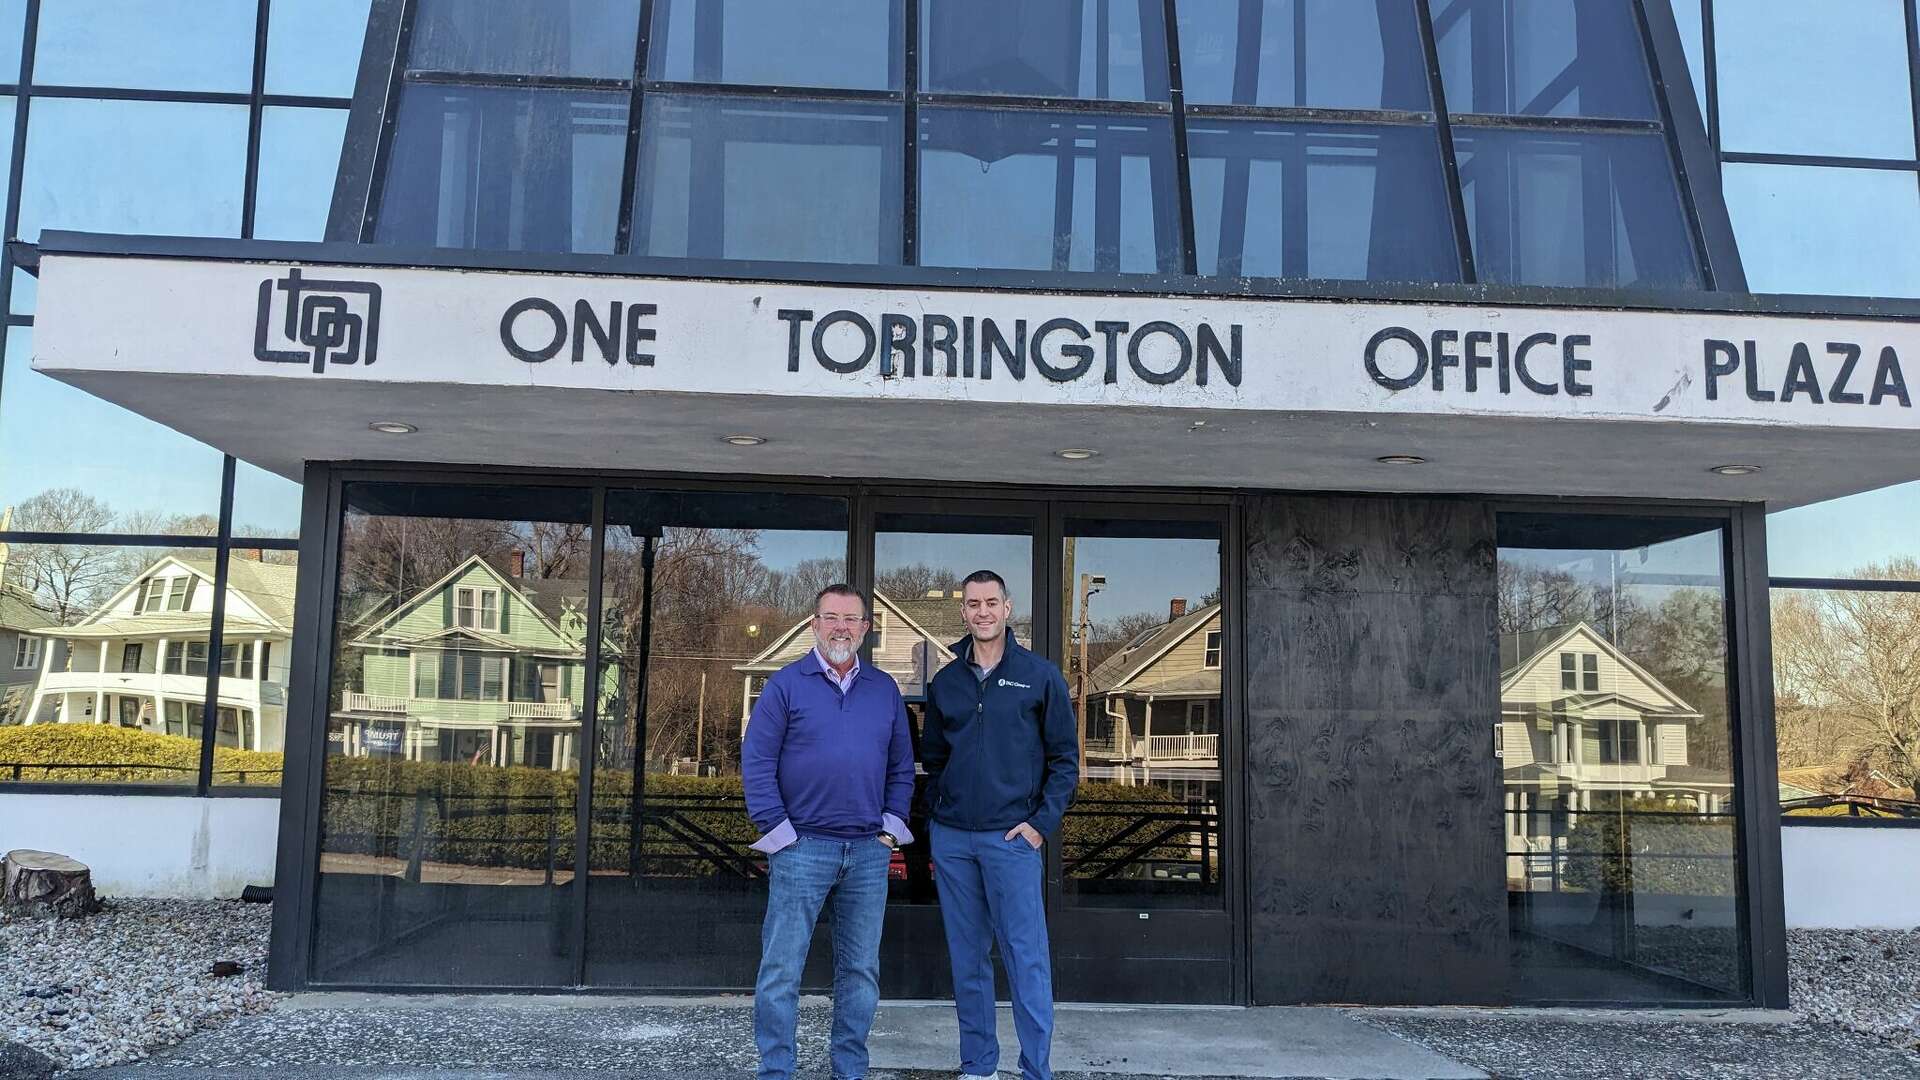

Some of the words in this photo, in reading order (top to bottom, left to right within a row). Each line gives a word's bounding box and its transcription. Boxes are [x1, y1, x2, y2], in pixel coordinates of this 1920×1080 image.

[499, 297, 657, 366] ONE
[778, 309, 1243, 387] TORRINGTON
[1364, 326, 1592, 396] OFFICE
[1704, 339, 1911, 407] PLAZA
